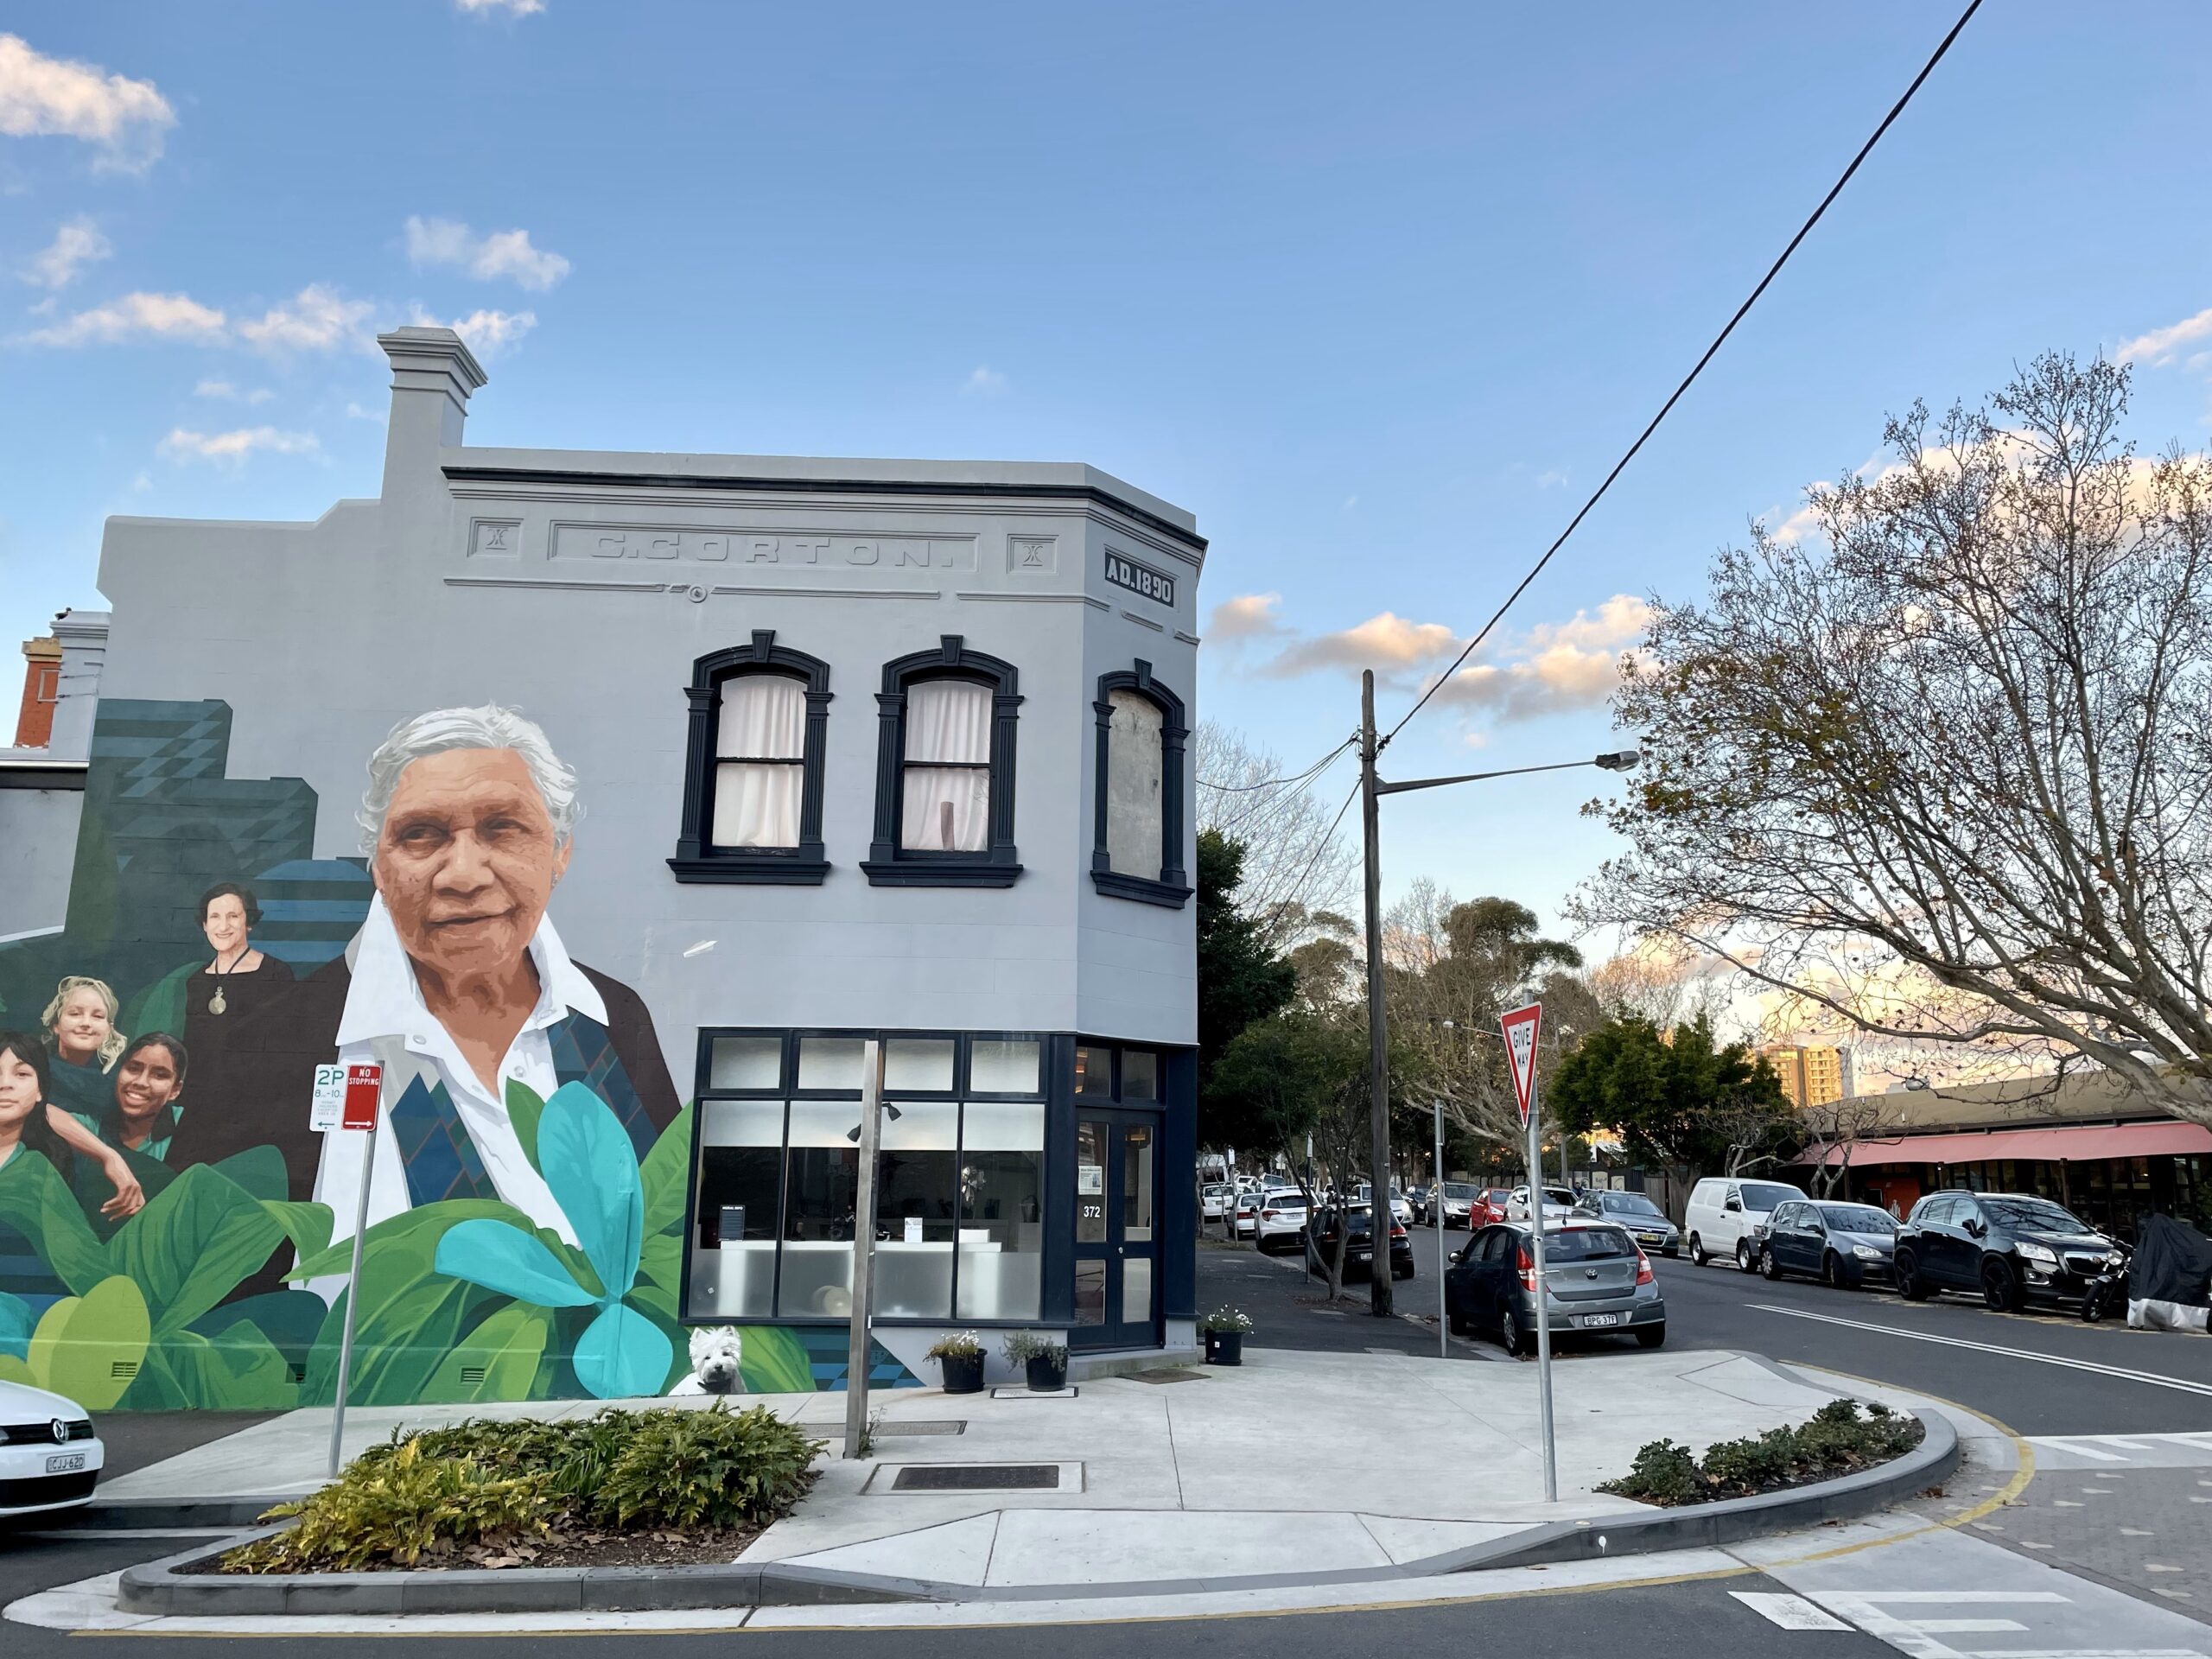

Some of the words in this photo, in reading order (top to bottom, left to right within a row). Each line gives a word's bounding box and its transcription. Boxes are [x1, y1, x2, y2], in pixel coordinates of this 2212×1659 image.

[1513, 1027, 1531, 1049] GIVE
[1516, 1052, 1529, 1069] WAY
[317, 1070, 345, 1085] 2P
[359, 1068, 371, 1077] NO
[1083, 1205, 1101, 1217] 372
